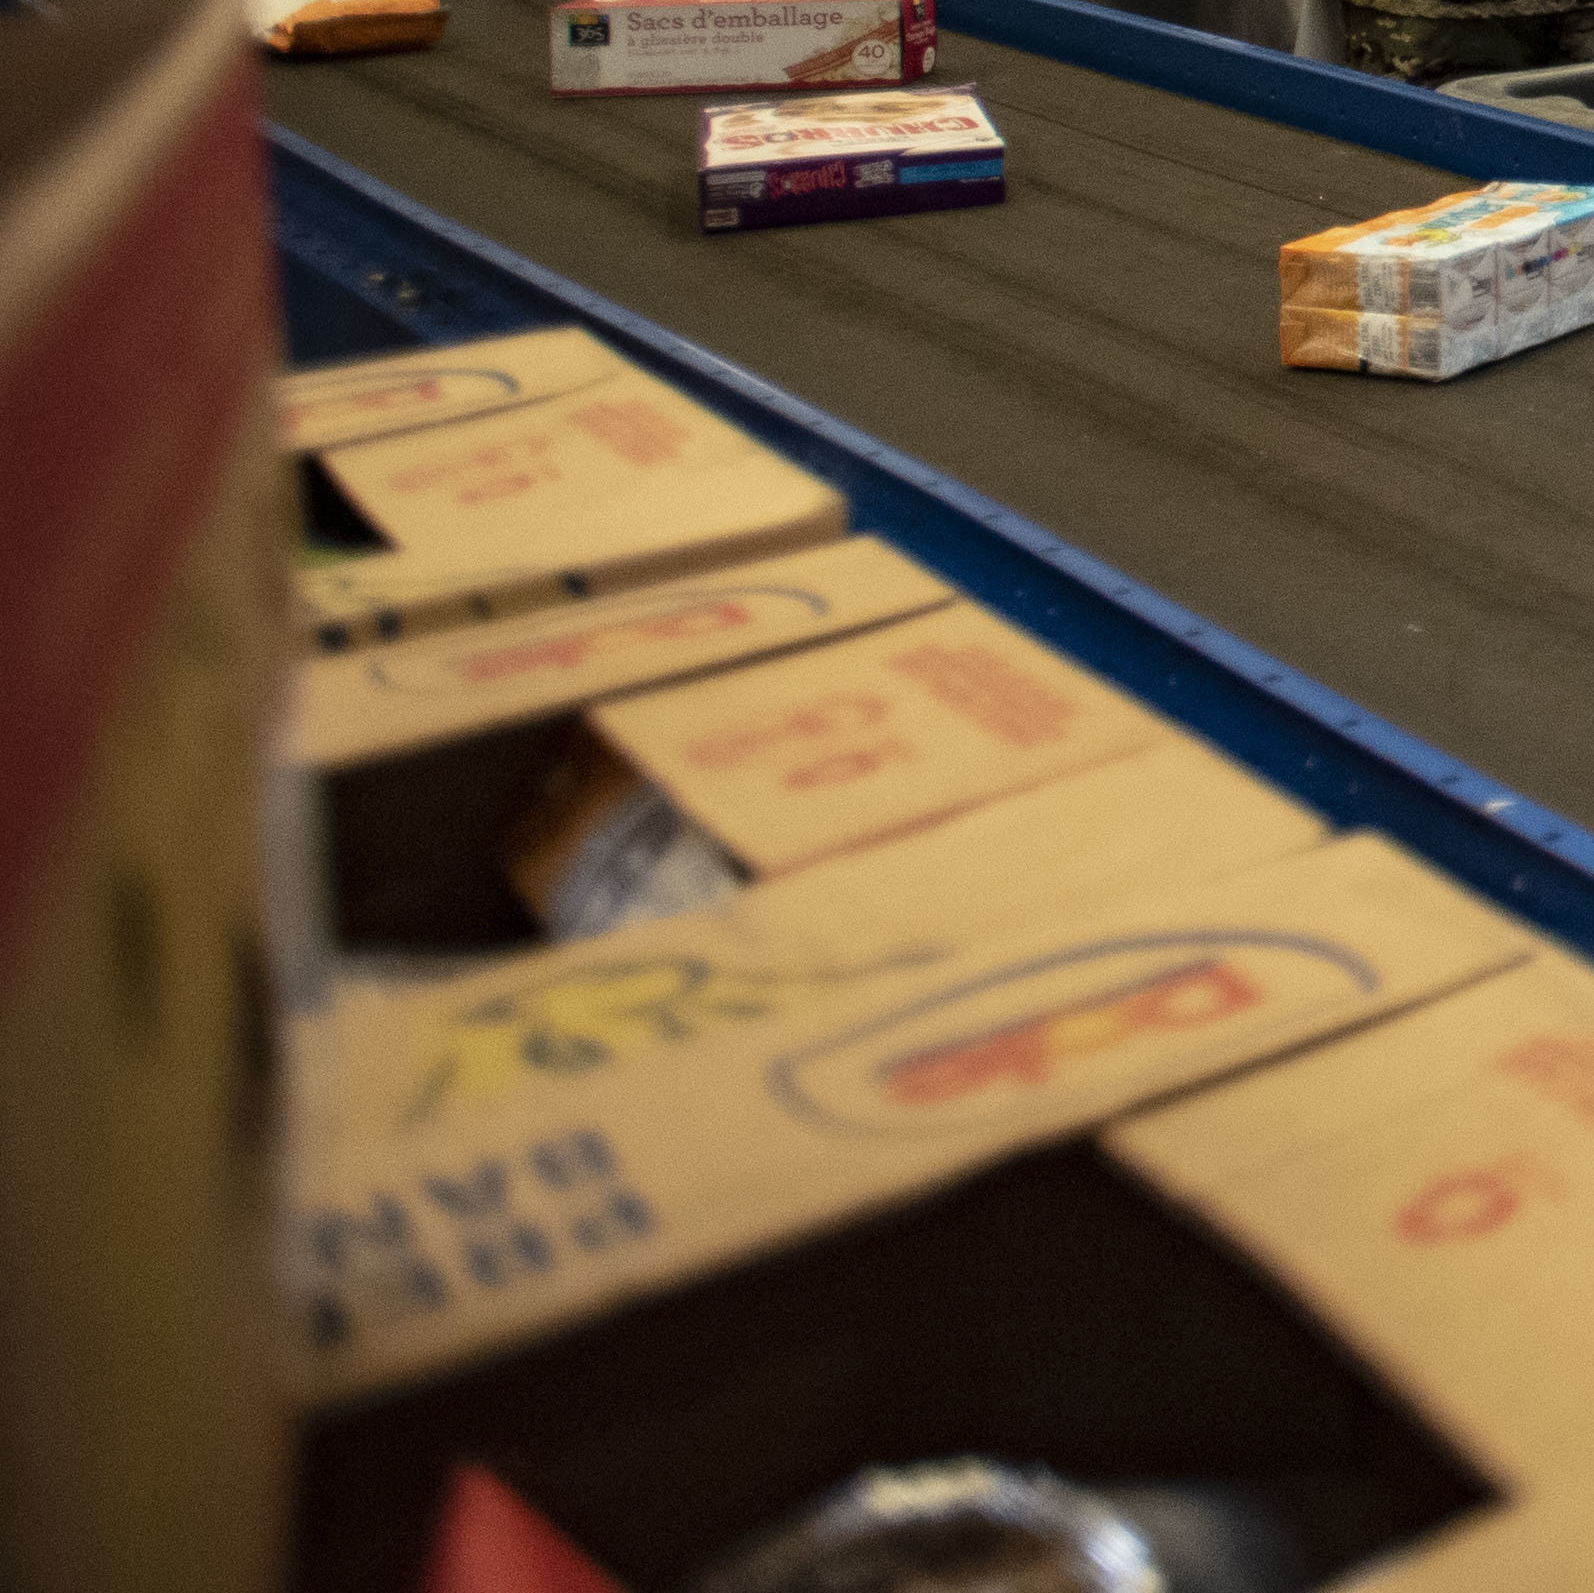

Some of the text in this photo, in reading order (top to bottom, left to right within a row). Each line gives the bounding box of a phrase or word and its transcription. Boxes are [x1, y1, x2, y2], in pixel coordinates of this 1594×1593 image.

[626, 10, 684, 32] Sacs
[711, 30, 765, 45] double
[858, 43, 885, 59] 40
[721, 116, 979, 150] CHURROS
